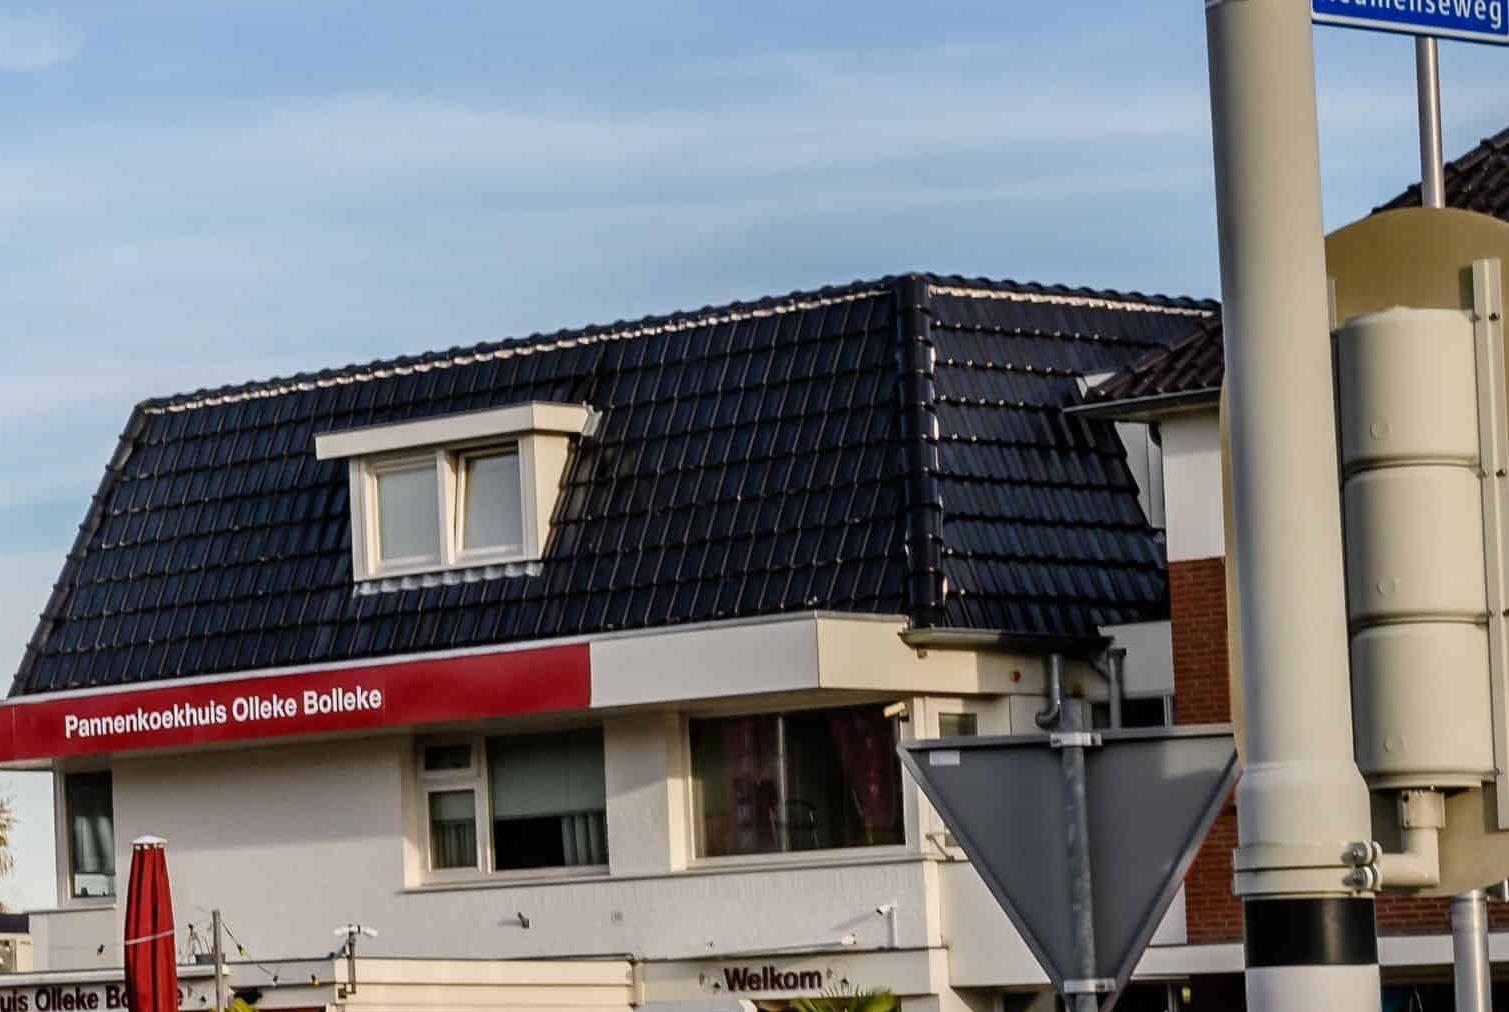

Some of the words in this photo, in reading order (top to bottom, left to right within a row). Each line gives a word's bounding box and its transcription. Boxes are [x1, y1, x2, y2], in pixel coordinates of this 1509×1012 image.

[64, 700, 227, 739] Pannenkoekhuis
[231, 694, 297, 723] Olleke
[303, 685, 382, 715] Bolleke
[724, 965, 823, 992] Welkom
[34, 986, 99, 1012] Olleke
